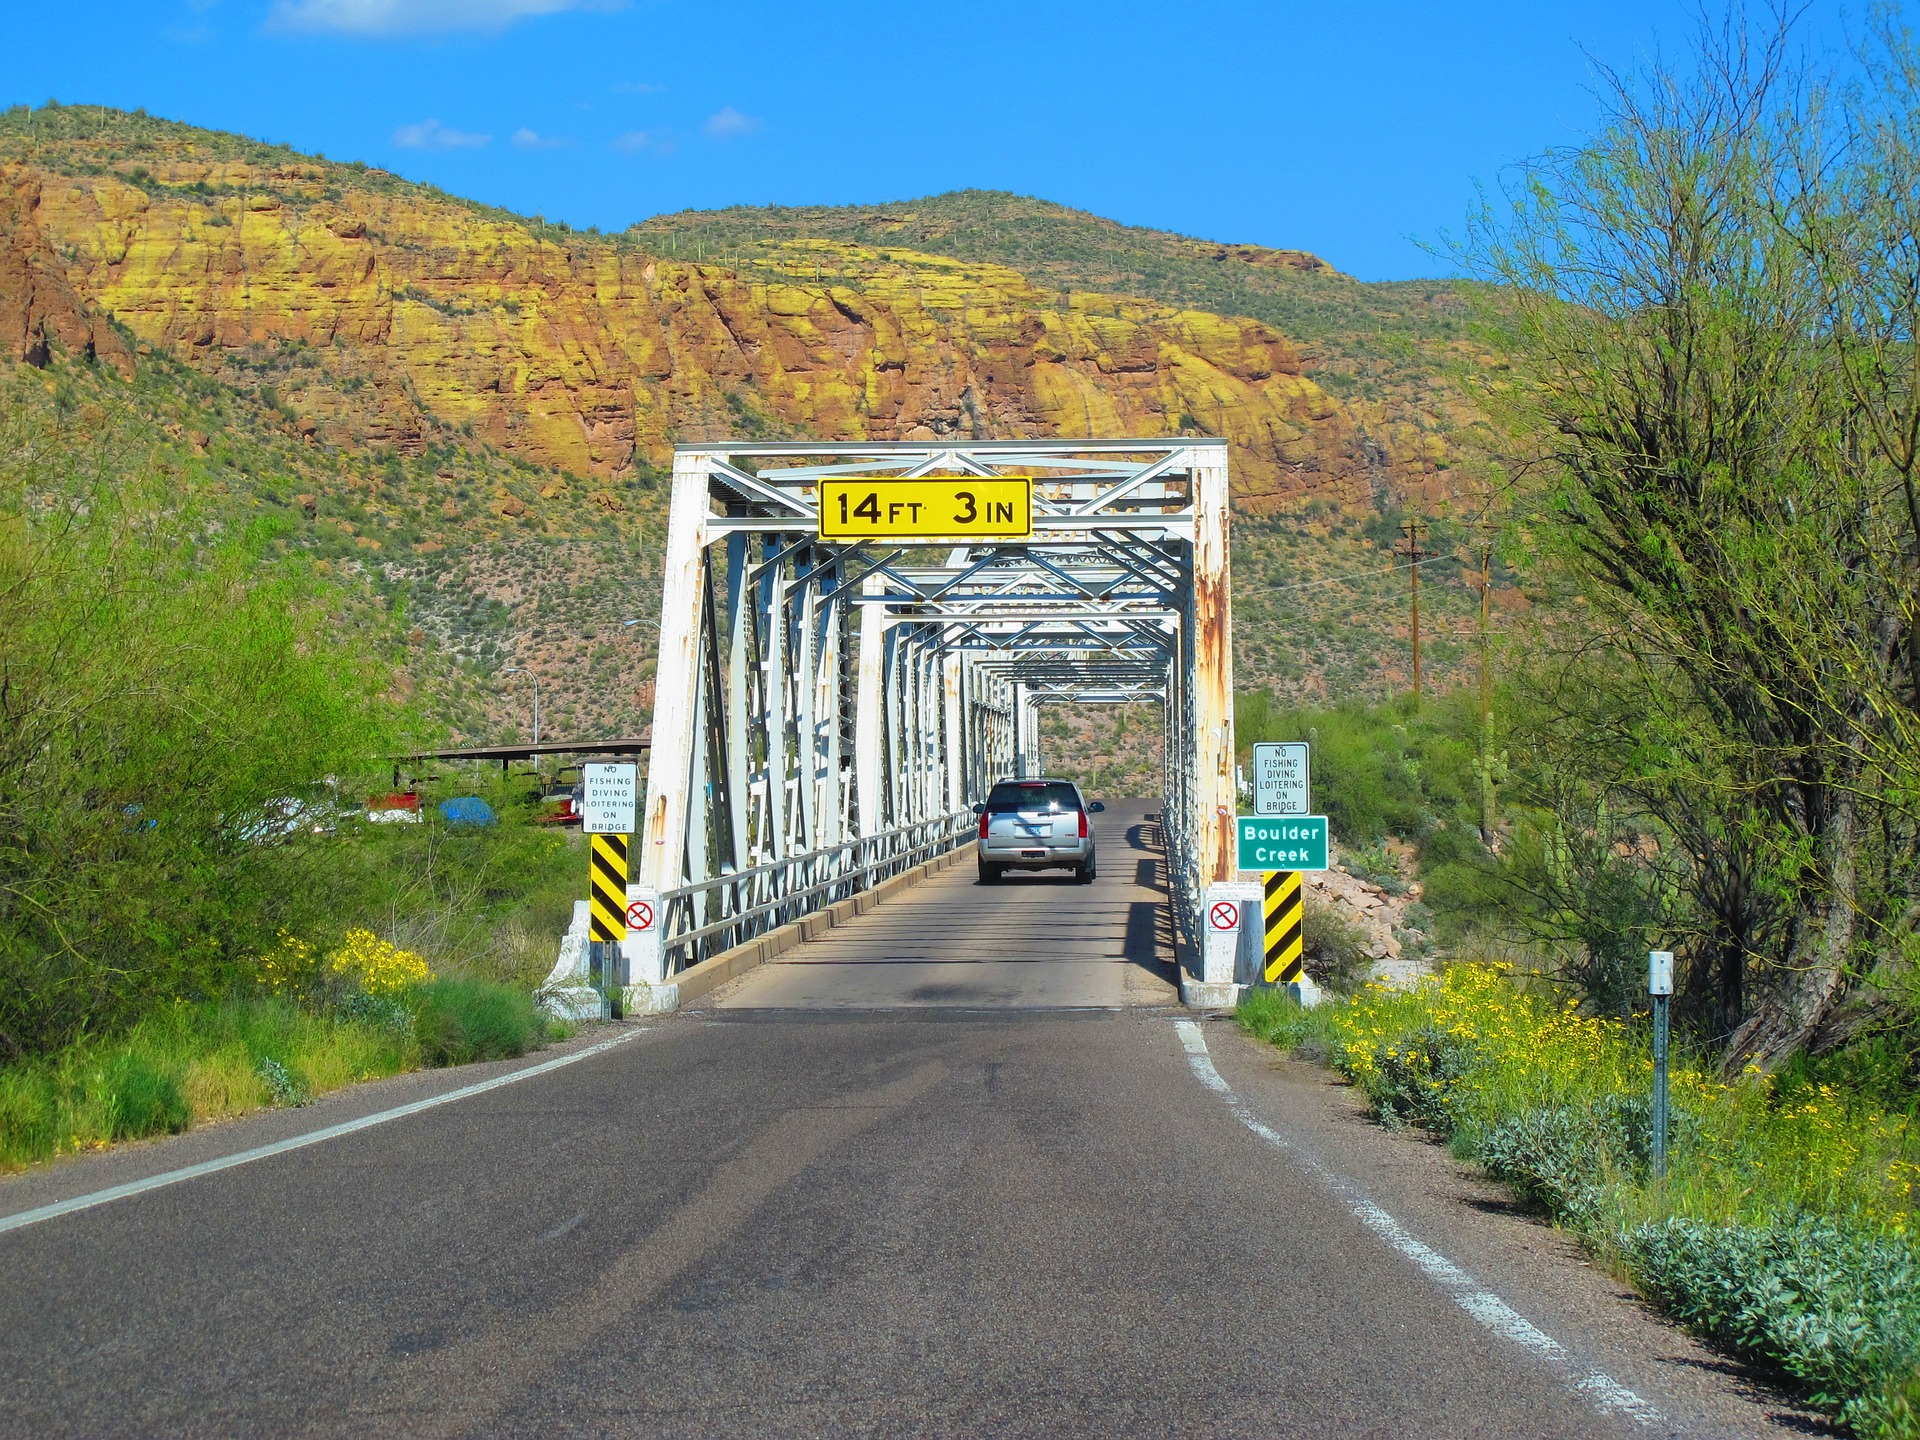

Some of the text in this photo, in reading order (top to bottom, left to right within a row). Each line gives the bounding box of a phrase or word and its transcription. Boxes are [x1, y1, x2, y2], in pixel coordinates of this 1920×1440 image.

[1275, 748, 1287, 758] NO
[1264, 759, 1298, 768] FISHING
[1267, 769, 1296, 779] DIVING
[589, 777, 631, 785] FISHING
[1259, 780, 1304, 790] LOITERING
[592, 789, 628, 797] DIVING
[1276, 790, 1288, 800] ON
[1266, 801, 1297, 811] BRIDGE
[602, 811, 617, 819] ON
[591, 823, 627, 831] BRIDGE
[1244, 826, 1319, 840] Boulder
[1255, 847, 1310, 862] Creek
